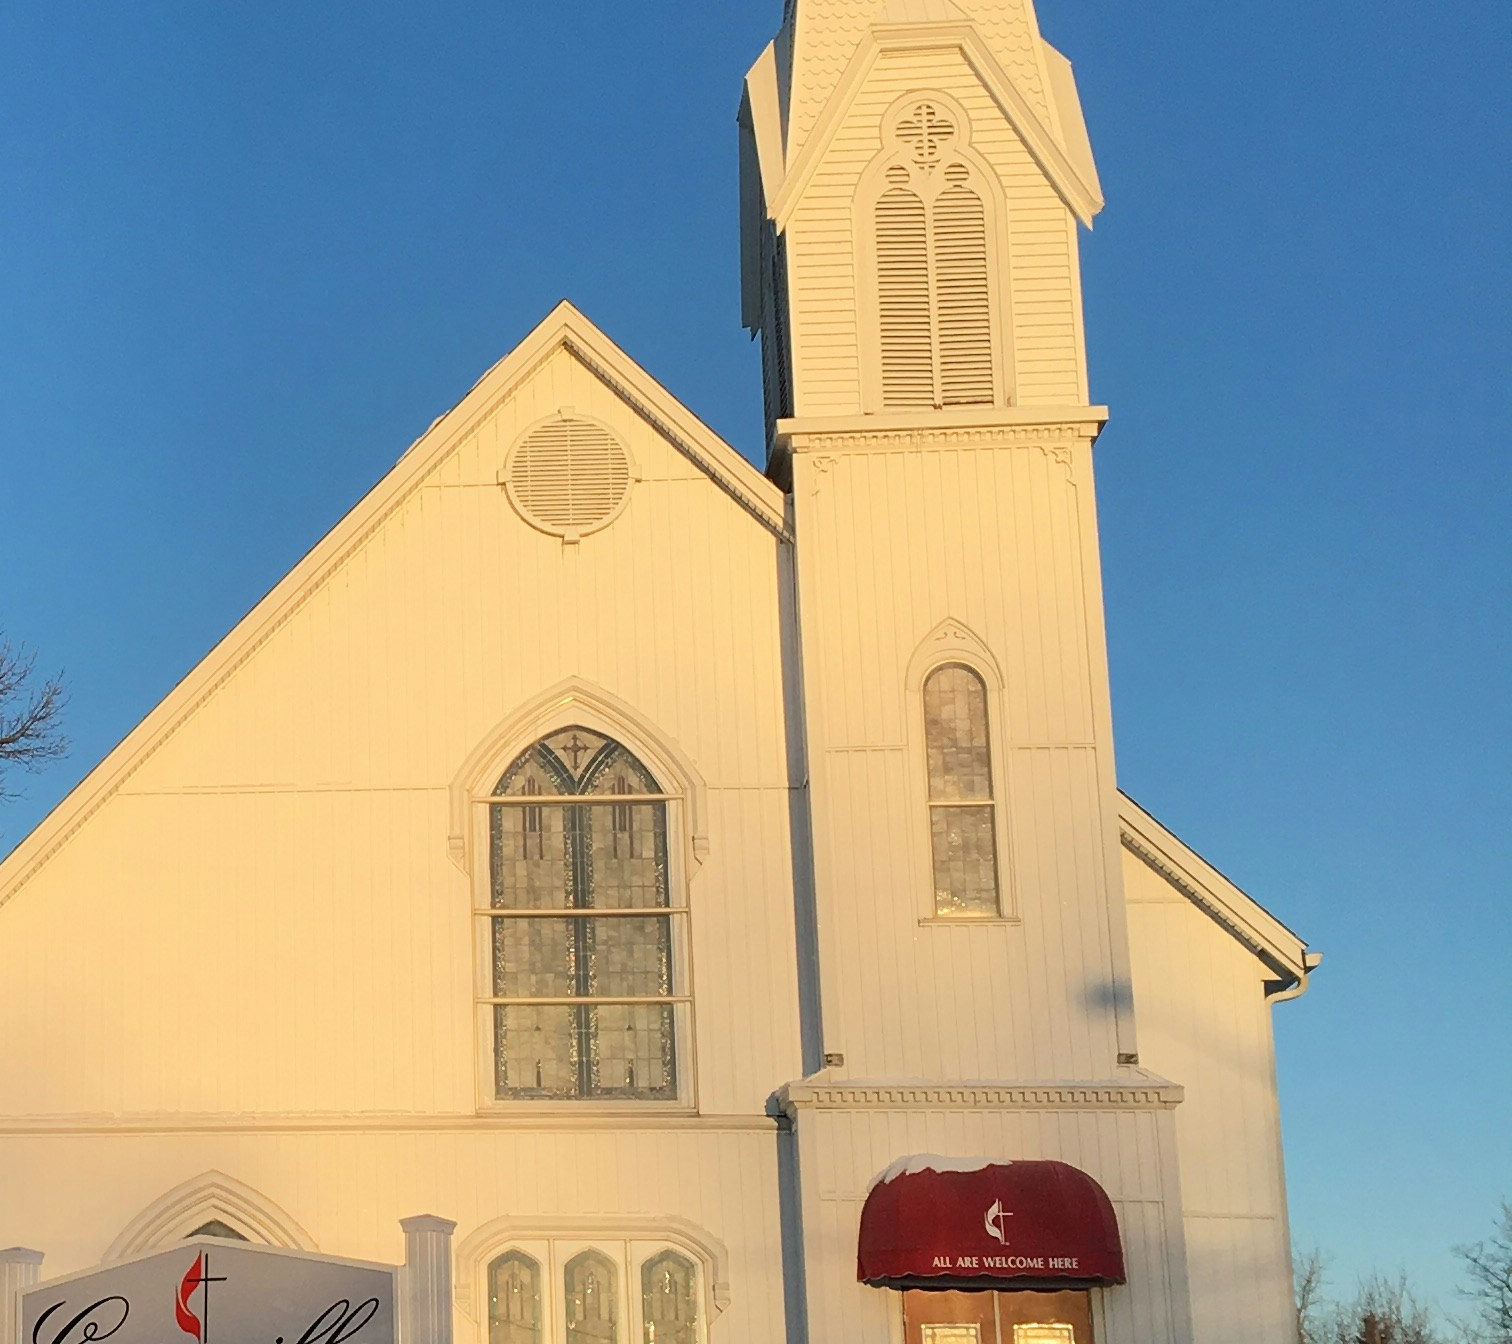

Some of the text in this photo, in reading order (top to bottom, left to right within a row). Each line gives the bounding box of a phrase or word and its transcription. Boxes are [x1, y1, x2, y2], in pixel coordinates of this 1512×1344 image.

[932, 1256, 1079, 1269] ALL ARE WELCOME HERE
